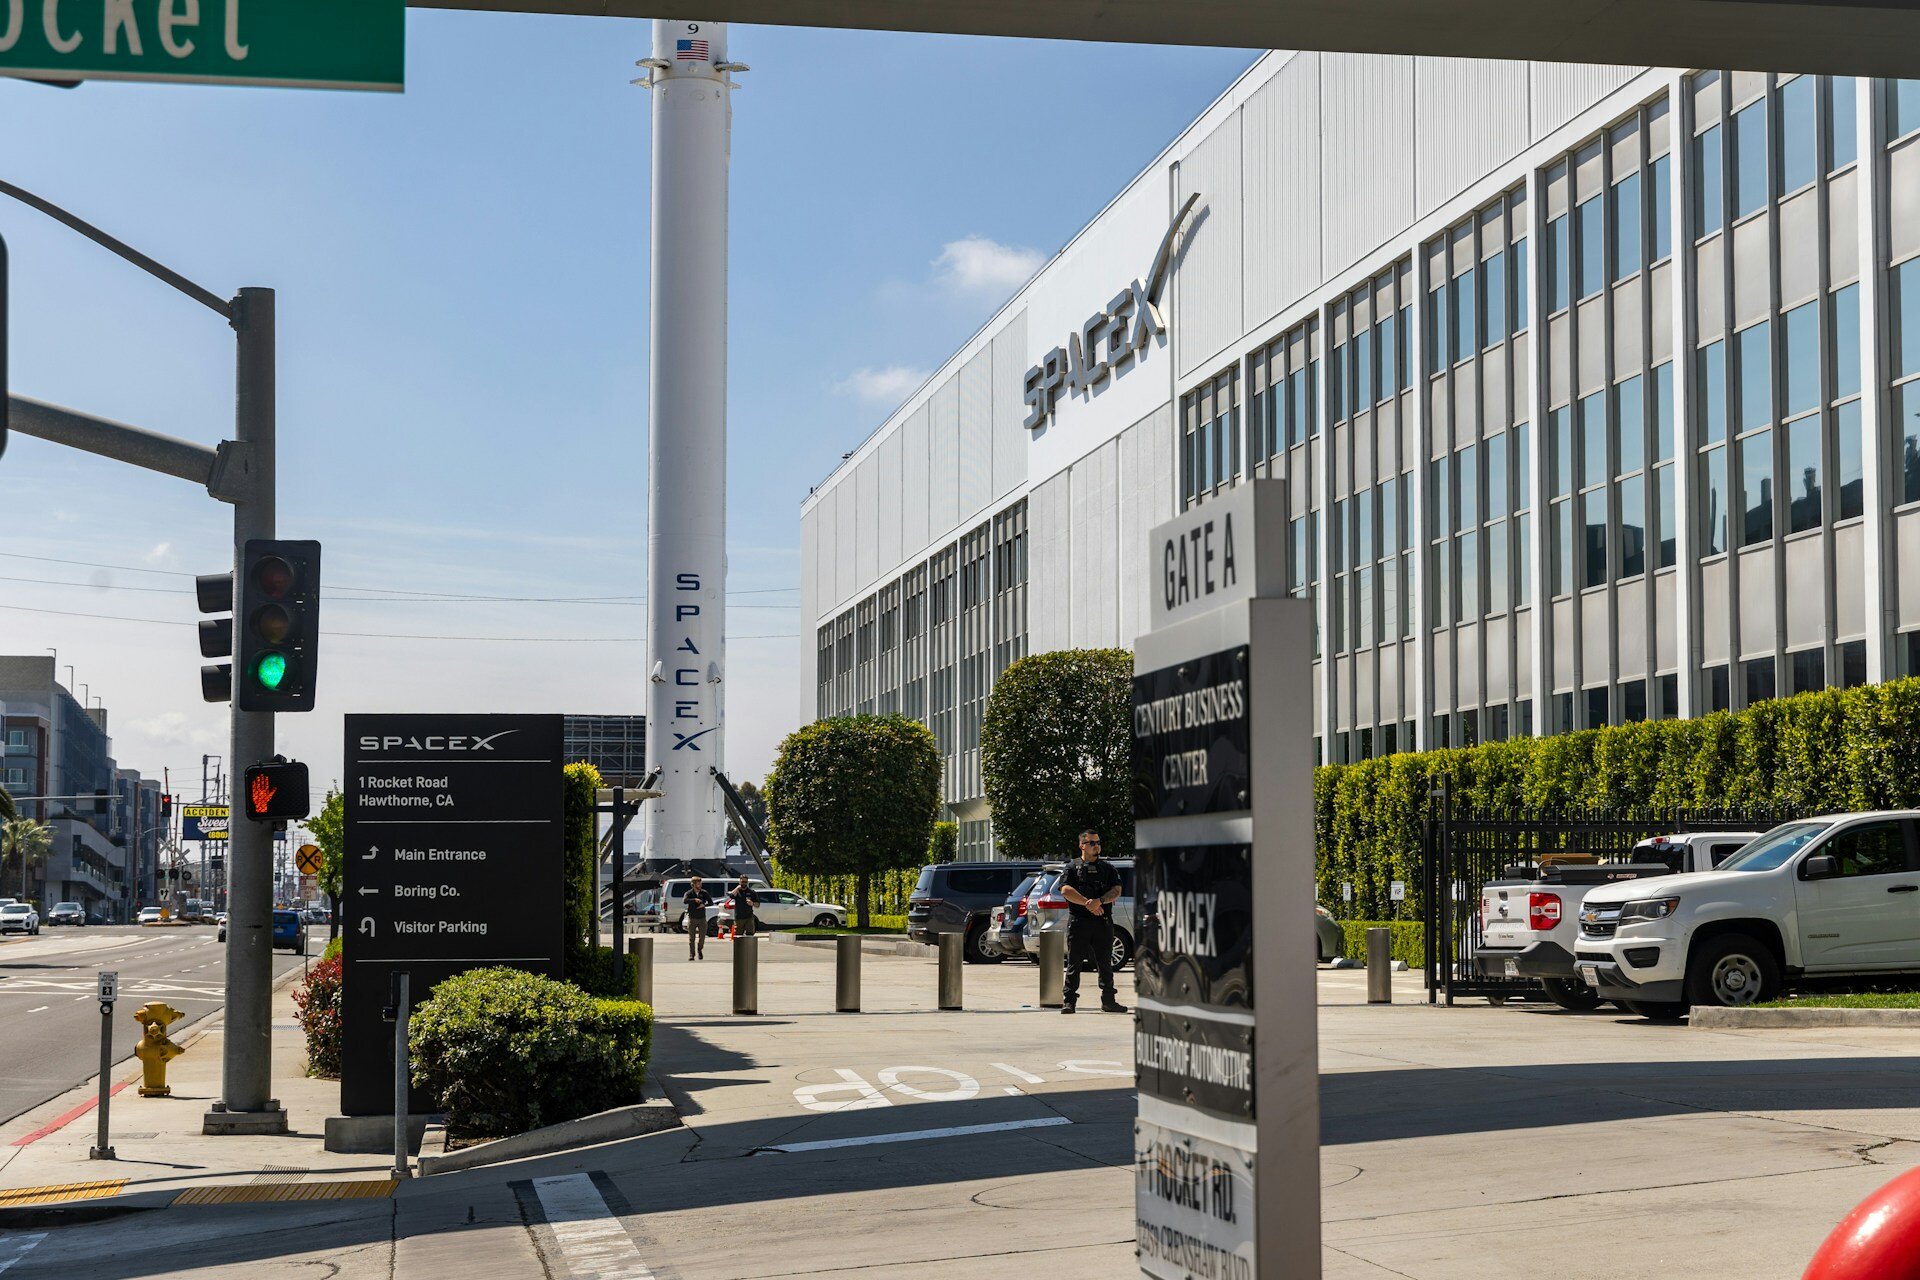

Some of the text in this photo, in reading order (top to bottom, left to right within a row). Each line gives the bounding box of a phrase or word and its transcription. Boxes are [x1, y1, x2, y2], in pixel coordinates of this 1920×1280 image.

[687, 23, 699, 35] 9
[1023, 193, 1201, 429] SPACEX
[1164, 512, 1236, 611] GATE A
[672, 574, 721, 751] SPACEX
[1134, 679, 1243, 738] CENTURY BUSINESS
[359, 729, 521, 751] SPACEX
[359, 776, 449, 788] 1 Rocket Road
[1162, 749, 1208, 790] CENTER
[185, 807, 229, 816] ACCIDEN
[359, 794, 455, 808] Hawthorne, CA
[394, 849, 487, 861] Main Entrance
[394, 885, 461, 899] Boring Co.
[394, 921, 488, 935] Visitor Parking
[1158, 890, 1217, 957] SPACEX
[1137, 1031, 1250, 1091] BULLETPROOF AUTOMOTIVE
[1157, 1141, 1208, 1213] ROCKET
[1212, 1159, 1236, 1224] RD.
[1161, 1225, 1218, 1279] CRENSHAW
